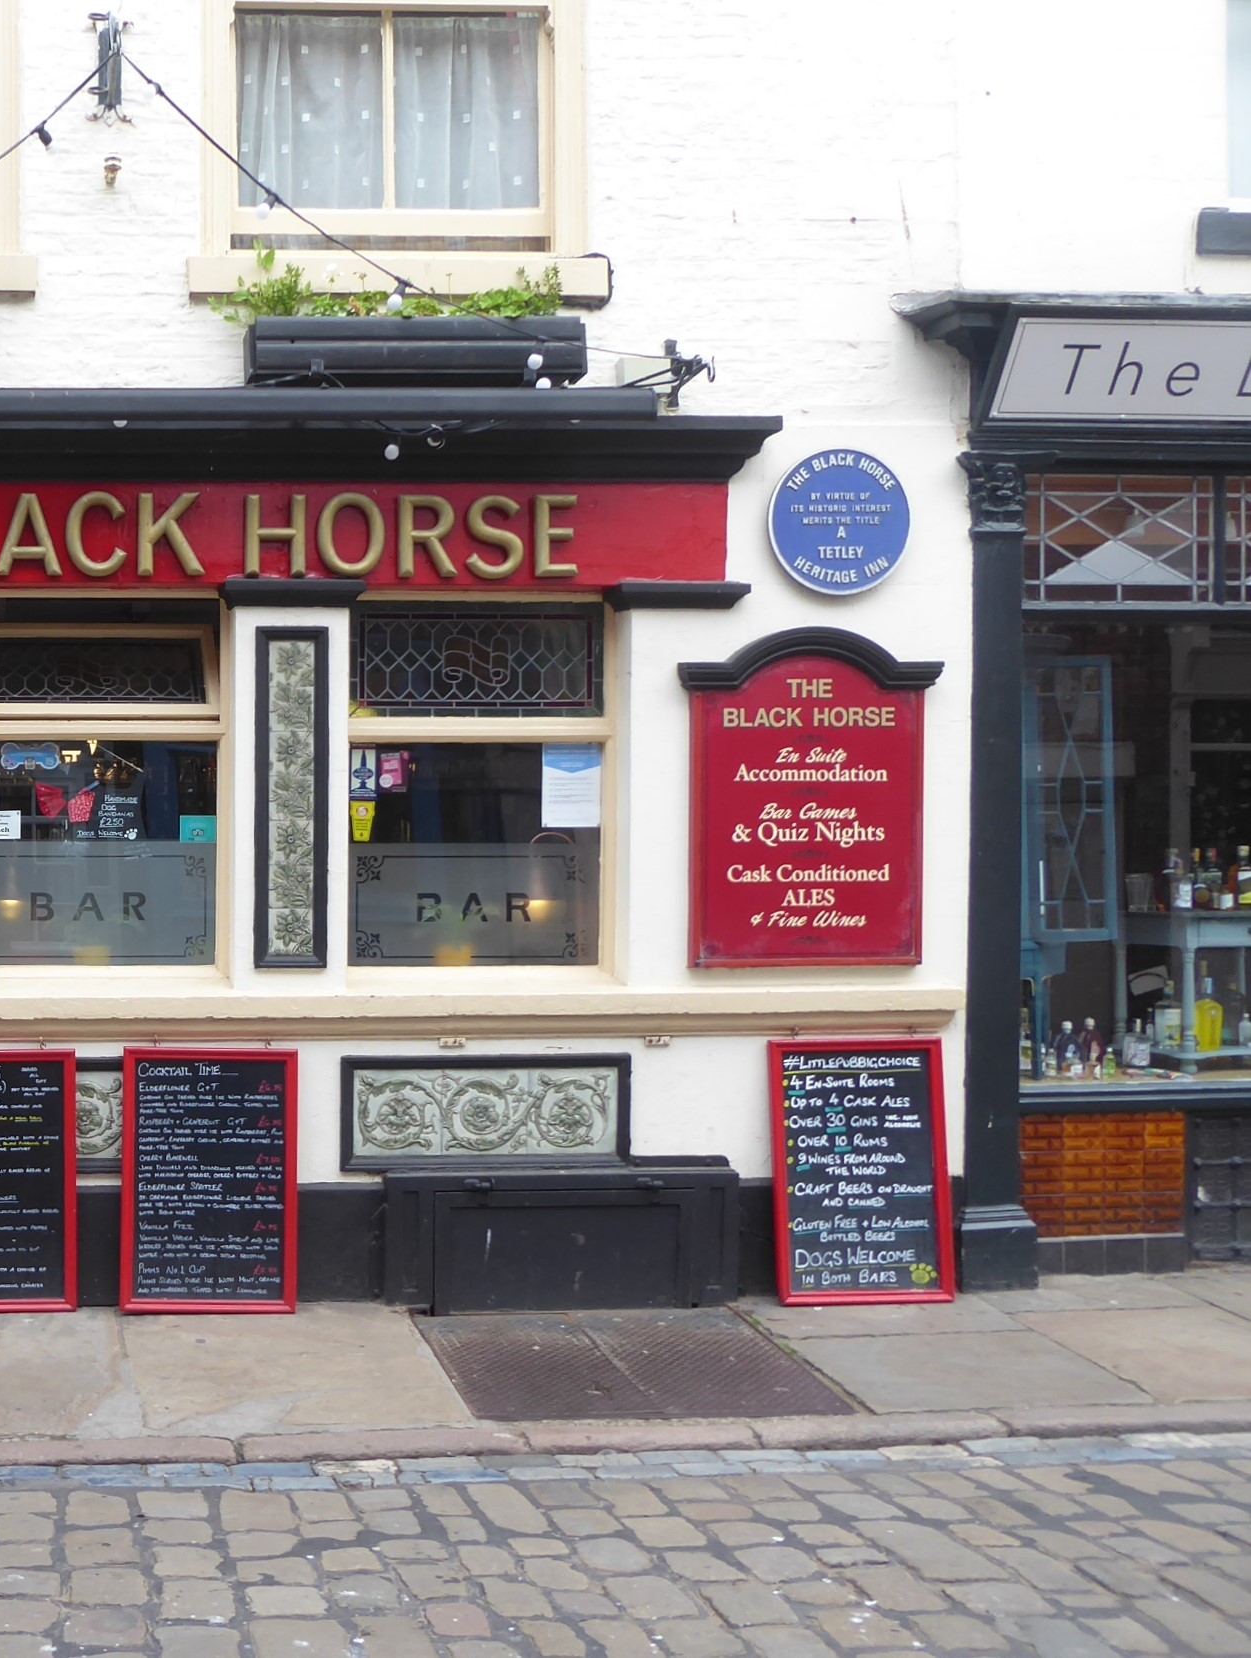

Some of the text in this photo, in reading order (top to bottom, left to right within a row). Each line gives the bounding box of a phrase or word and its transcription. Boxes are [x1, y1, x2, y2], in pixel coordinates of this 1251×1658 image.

[1063, 341, 1200, 397] The
[786, 453, 895, 491] THE BLACK HORSE
[810, 492, 870, 500] BY VIRTUE OF
[790, 504, 891, 512] ITS HISTORIC INTEREST
[802, 516, 880, 524] MERITS THE TITLE
[244, 491, 578, 580] HORSE
[836, 525, 846, 539] A
[818, 546, 864, 559] TETLEY
[794, 556, 889, 584] HERITAGE INN
[787, 678, 833, 698] THE
[723, 707, 895, 728] BLACK HORSE
[776, 746, 847, 763] En Suite
[734, 763, 888, 782] Accommodation
[98, 810, 134, 818] BANDANAS
[101, 803, 117, 811] DOG
[759, 803, 857, 820] Bar Games
[732, 822, 885, 847] & Quiz Nights
[727, 864, 890, 882] Cask Conditioned
[781, 888, 835, 908] ALES
[30, 892, 147, 921] BAR
[416, 892, 532, 922] BAR
[768, 911, 807, 927] Fine
[813, 911, 867, 927] Wines
[138, 1062, 221, 1077] COCKTAIL TIME
[783, 1055, 921, 1070] #LITTLEPUBBIGCHOICE
[139, 1082, 190, 1092] ELDERFLOWER
[790, 1073, 895, 1090] 4 EN-SUITE ROOMS
[790, 1093, 910, 1109] UP TO 4 CASK ALES
[789, 1112, 878, 1128] OVER 30 GINS
[797, 1133, 888, 1147] OVER 10 RUMS
[166, 1153, 198, 1161] BAKEWELL
[798, 1152, 905, 1165] 9 WINES FROM AROUND
[825, 1165, 886, 1176] THE WORLD
[794, 1181, 933, 1196] CRAFT BEERS ON DRAUGHT
[821, 1196, 885, 1207] AND CANNED
[139, 1221, 168, 1230] VANILLA
[792, 1217, 832, 1231] GLUTEN
[834, 1214, 858, 1229] FREE
[871, 1215, 891, 1228] LOW
[891, 1216, 930, 1228] ALCOHOL
[820, 1230, 896, 1242] BOTTLED BEERS
[795, 1245, 916, 1268] DOGS WELCOME
[188, 1264, 206, 1274] CUP
[802, 1269, 897, 1285] IN BOTH BARS
